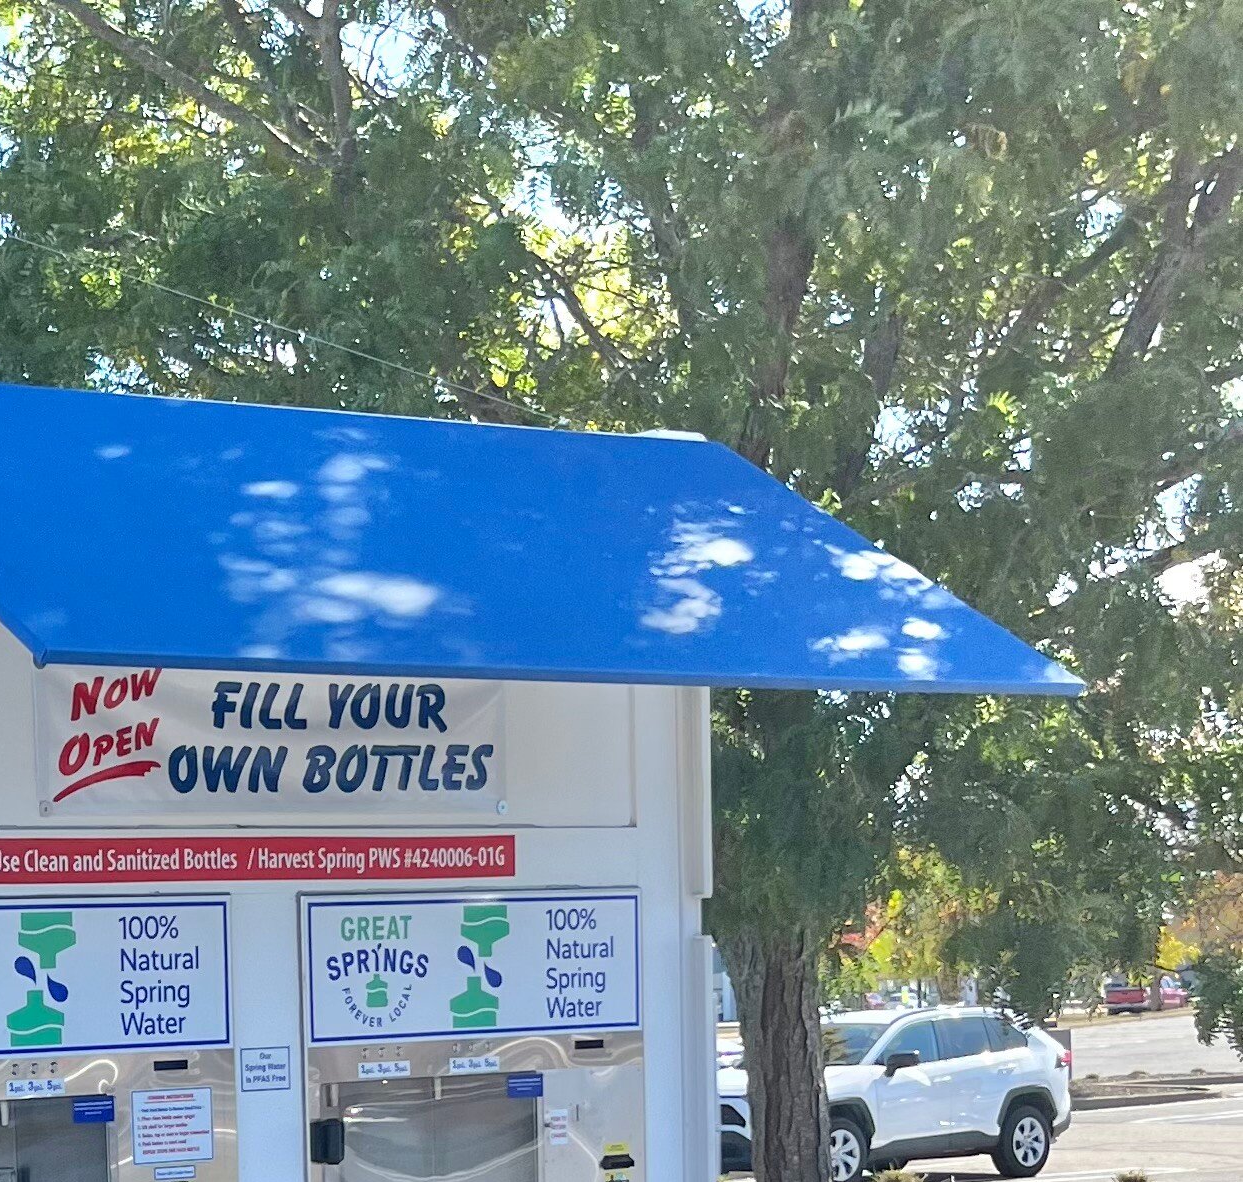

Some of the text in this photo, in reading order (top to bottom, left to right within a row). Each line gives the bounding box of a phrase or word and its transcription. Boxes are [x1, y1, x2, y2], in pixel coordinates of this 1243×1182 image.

[211, 681, 447, 733] FILL YOUR
[58, 717, 159, 776] OPEN
[168, 744, 494, 793] OWN BOTTLES
[23, 848, 69, 872] Clean
[72, 848, 103, 872] and
[106, 848, 180, 871] Sanitized
[183, 847, 238, 871] Bottles
[317, 846, 365, 874] Spring
[368, 847, 401, 869] PWS
[403, 845, 505, 868] #4240006-01G
[118, 915, 179, 940] 100%
[340, 915, 412, 941] GREAT
[545, 908, 597, 930] 100%
[120, 945, 199, 971] Natural
[546, 935, 614, 959] Natural
[326, 943, 429, 981] SPRINGS
[546, 966, 606, 994] Spring
[120, 979, 190, 1010] Spring
[342, 984, 412, 1027] FOREVER LOCAL
[546, 996, 602, 1019] Water
[120, 1012, 186, 1036] Water
